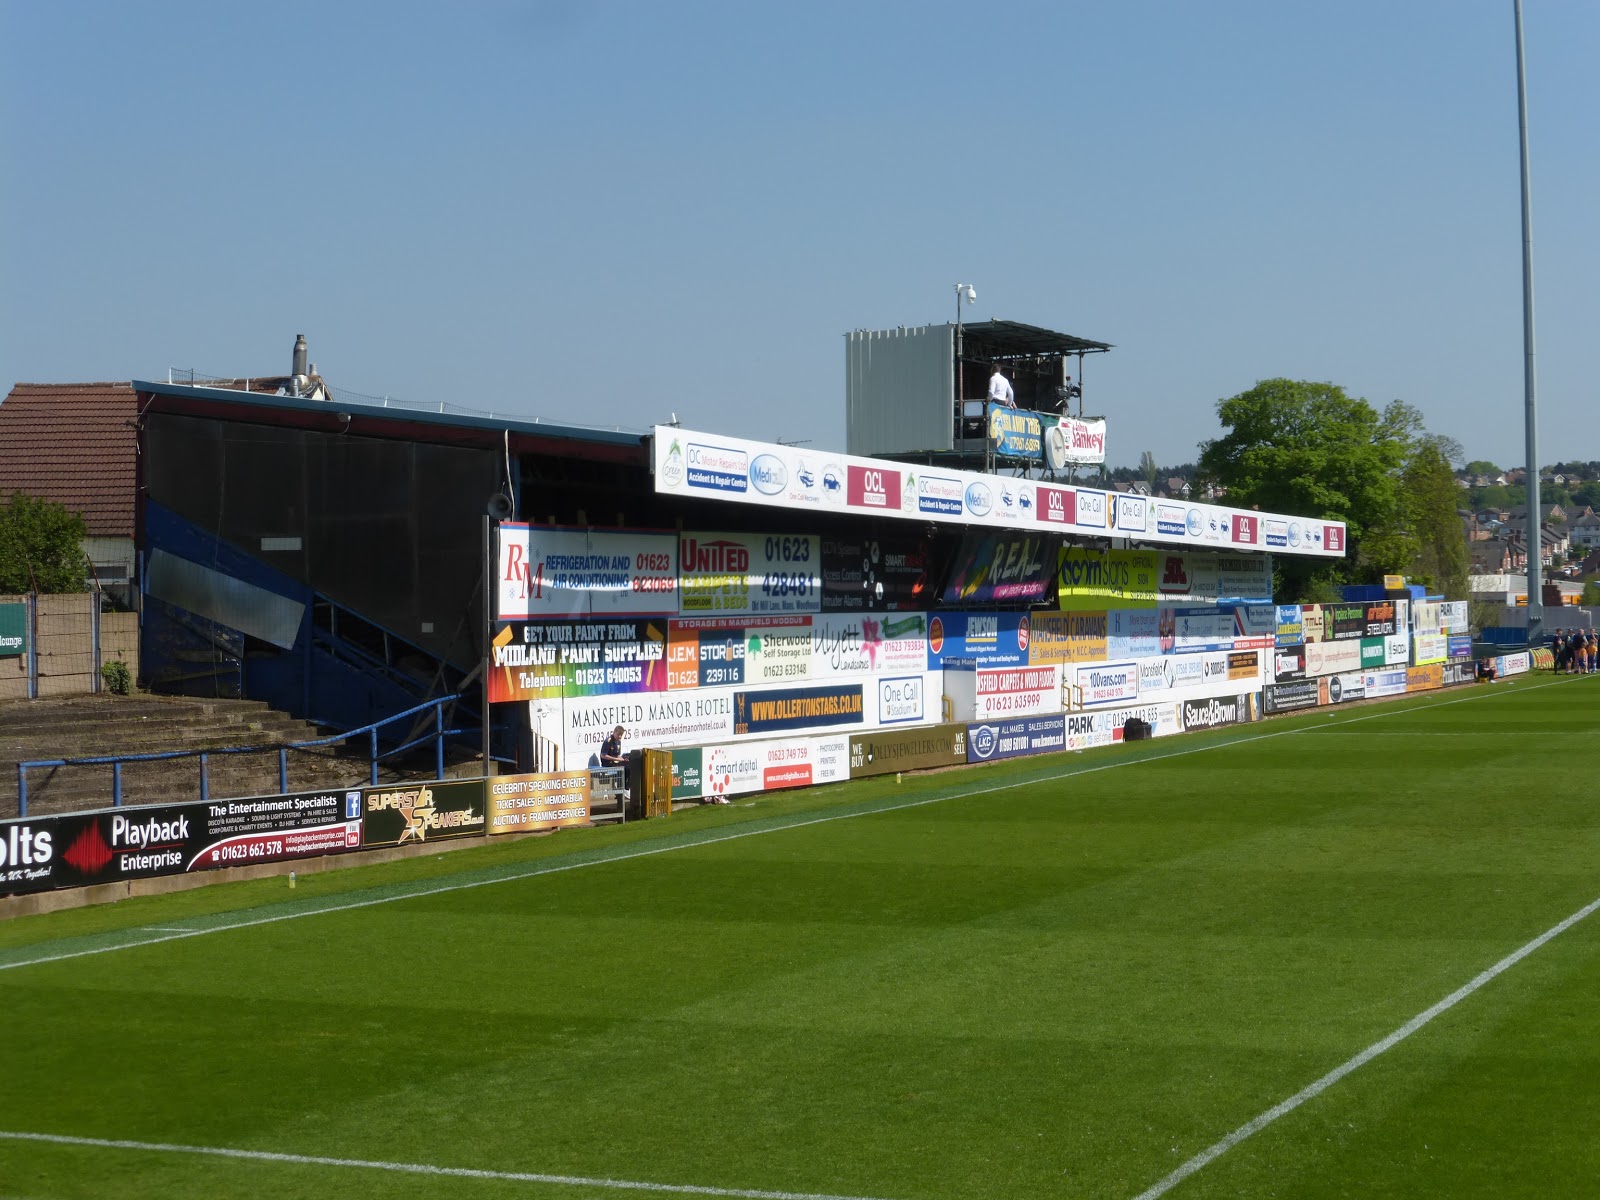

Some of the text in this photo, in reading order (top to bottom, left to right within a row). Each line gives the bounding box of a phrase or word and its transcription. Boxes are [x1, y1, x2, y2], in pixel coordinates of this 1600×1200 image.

[702, 455, 718, 467] Motor
[719, 457, 737, 470] Repairs
[738, 461, 746, 471] Ltd
[689, 472, 747, 488] Accident & Repair Centre
[864, 471, 885, 492] OCL
[920, 500, 961, 511] Accident Repair Centre
[1049, 491, 1064, 510] OCL
[1080, 497, 1101, 512] One Call
[1123, 502, 1142, 517] One Call
[1240, 518, 1250, 532] OCL
[682, 538, 749, 572] UNITED
[765, 536, 810, 562] 01623
[546, 555, 630, 570] REFRIGERATION AND
[637, 553, 670, 571] 01623
[553, 573, 629, 588] AIR CONDITIONING
[841, 569, 862, 581] Control
[1138, 574, 1148, 585] SIGN
[632, 576, 674, 593] 623069
[682, 574, 749, 595] CARPETS
[762, 572, 814, 597] 428481
[714, 597, 722, 609] &
[723, 596, 748, 609] BEDS
[843, 595, 863, 607] Alarms
[678, 619, 716, 628] STORAGE
[728, 617, 771, 626] MANSFIELD
[966, 617, 998, 637] JEWSON
[1031, 616, 1106, 643] MANSFIELD CARAVANS
[524, 624, 636, 642] GET YOUR PAINT FROM
[764, 632, 811, 647] Sherwood
[495, 641, 663, 667] MIDLAND PAINT SUPPLIES
[764, 647, 811, 659] Self Storage Ltd
[885, 641, 902, 652] 01623
[706, 668, 739, 682] 239116
[764, 664, 807, 677] 01623 633148
[1140, 662, 1163, 678] Mansfield
[520, 667, 642, 690] Telephone 01623 640053
[669, 671, 697, 686] 01623
[1000, 671, 1020, 691] CARPETS
[1020, 675, 1024, 690] &
[1025, 673, 1038, 689] WOOD
[1039, 670, 1055, 687] FLOORS
[1090, 672, 1126, 688] 100vans.com
[884, 683, 917, 702] One Call
[1094, 689, 1106, 698] 01623
[752, 695, 862, 721] WWW.OLLERTONSTAGS.CO.UK
[890, 703, 912, 716] Stadium
[986, 694, 1040, 711] 01623 635999
[572, 698, 731, 728] MANSFIELD MANOR HOTEL
[1148, 707, 1157, 721] 655
[1186, 699, 1236, 727] Sauce&Brown
[585, 719, 727, 744] 01623 www.mansfieldmanorhotel.co.uk
[1001, 720, 1063, 734] ALL MAKES SALES SERVICING
[955, 733, 964, 743] WE
[979, 736, 991, 748] LKC
[999, 737, 1012, 752] 01909
[768, 747, 808, 761] 01623 749 759
[820, 743, 845, 753] PHOTOCOPIERS
[853, 743, 862, 755] WE
[954, 744, 965, 755] SELL
[716, 758, 757, 775] smart digital
[820, 756, 836, 764] PRINTERS
[851, 755, 864, 767] BUY
[684, 767, 698, 777] coffee
[821, 769, 829, 777] FREE
[493, 777, 586, 795] CELEBRITY SPEAKING EVENTS
[684, 777, 700, 787] lounge
[209, 796, 337, 817] The Entertainment Specialists
[368, 788, 433, 811] SUPERSTAR
[496, 793, 583, 810] TICKET SALES & MEMORABILIA
[493, 808, 586, 826] AUCTION & FRAMING SERVICES
[112, 814, 189, 849] Playback
[209, 825, 234, 834] CORPORATE
[301, 817, 316, 825] SERVICE
[286, 832, 345, 844] info@playbackenterprise.com
[348, 835, 357, 844] Tube
[222, 841, 282, 860] 01623 662 578
[286, 840, 345, 852] www.playbackenterprise.com
[120, 851, 182, 872] Enterprise
